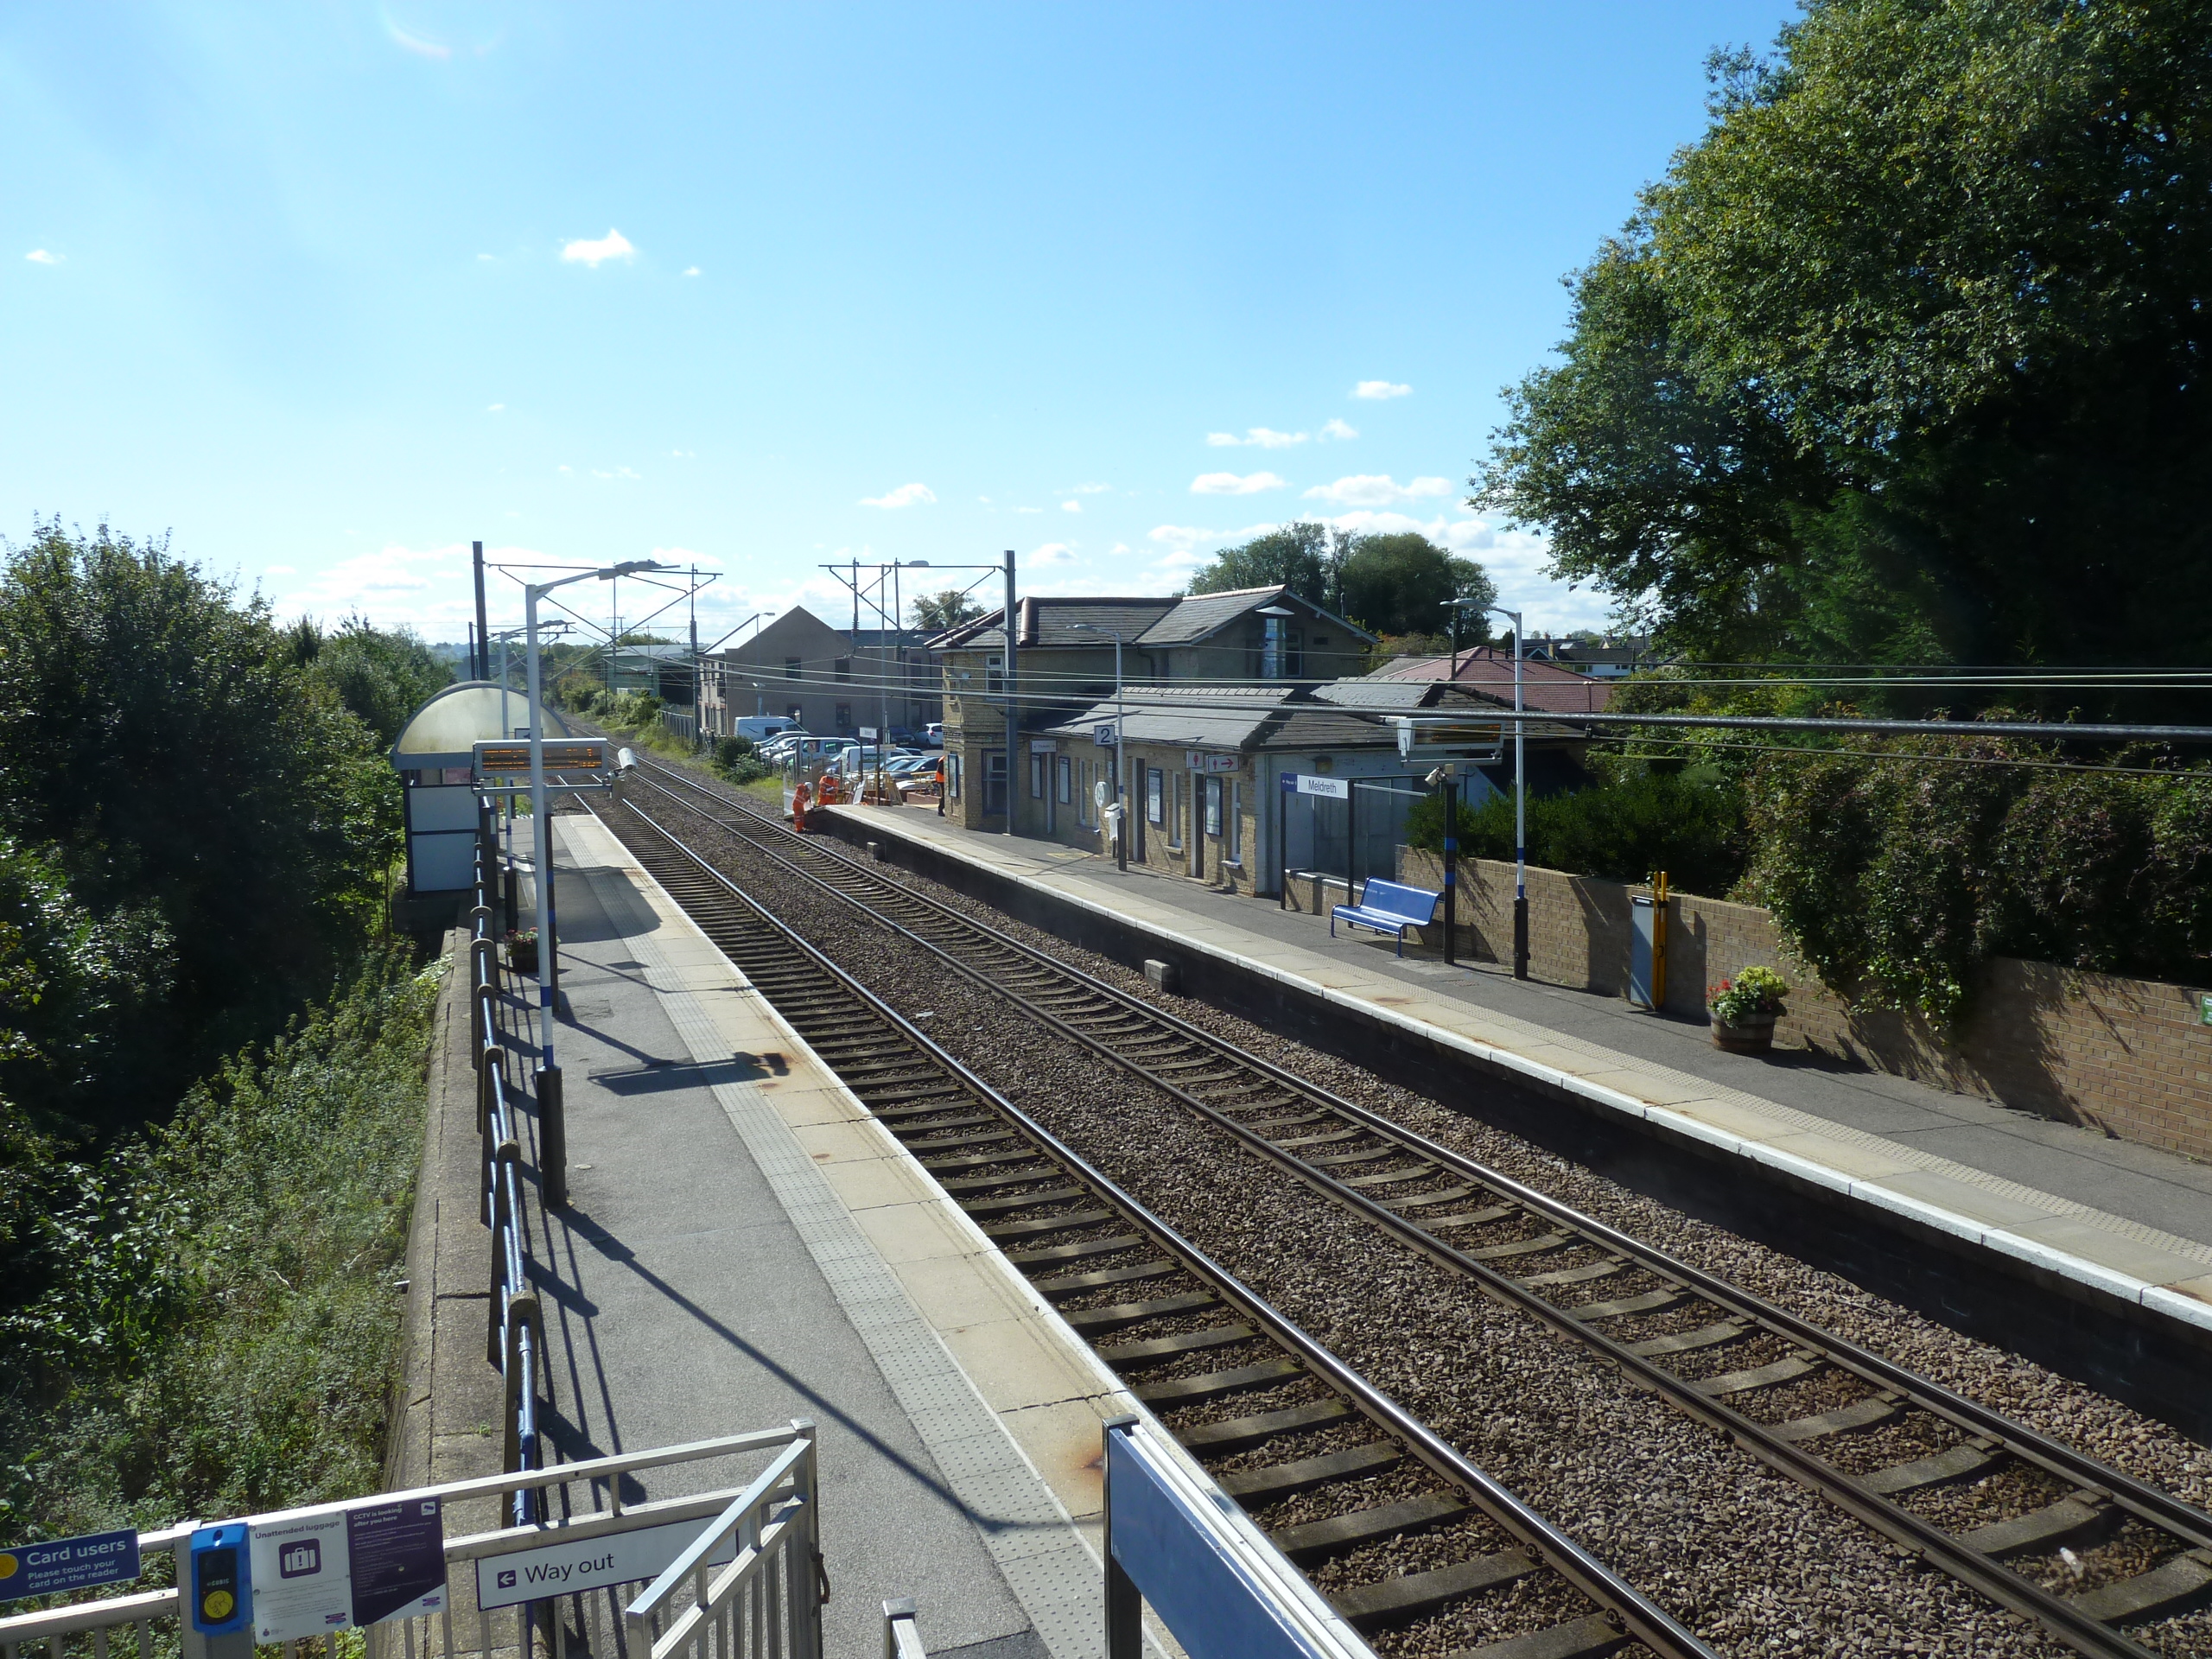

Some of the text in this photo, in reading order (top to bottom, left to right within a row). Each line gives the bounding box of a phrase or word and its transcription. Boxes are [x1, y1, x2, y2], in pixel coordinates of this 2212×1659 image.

[1100, 728, 1110, 743] 2
[1308, 779, 1337, 793] Meldreth
[255, 1526, 304, 1539] Unattended
[305, 1521, 340, 1531] luggage
[27, 1541, 126, 1566] Card users
[28, 1560, 116, 1580] Please touch your
[29, 1580, 50, 1589] card
[68, 1573, 85, 1582] the
[88, 1567, 118, 1579] reader
[524, 1554, 614, 1583] Way out
